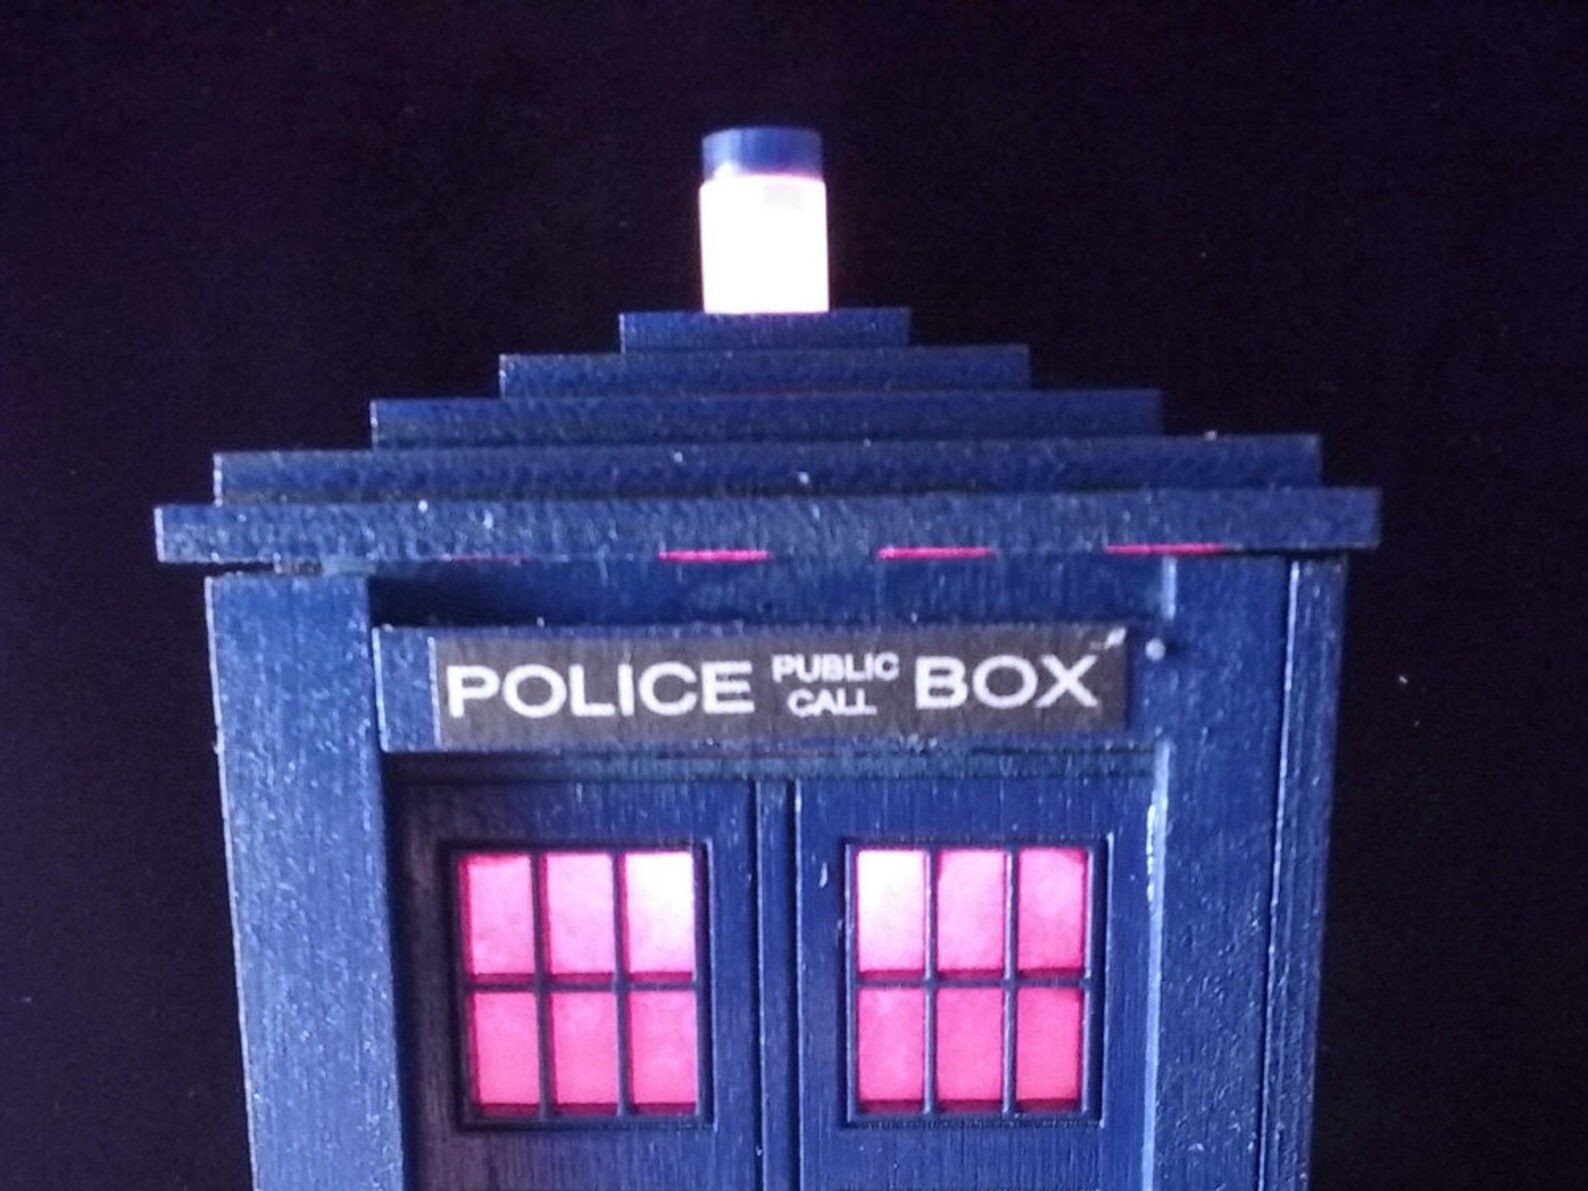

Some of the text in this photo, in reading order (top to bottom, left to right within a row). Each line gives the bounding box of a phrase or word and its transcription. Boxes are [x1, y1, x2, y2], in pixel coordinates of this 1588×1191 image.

[771, 653, 900, 681] PUBLIC
[915, 654, 1099, 710] BOX
[445, 660, 755, 719] POLICE
[788, 688, 877, 716] CALL
